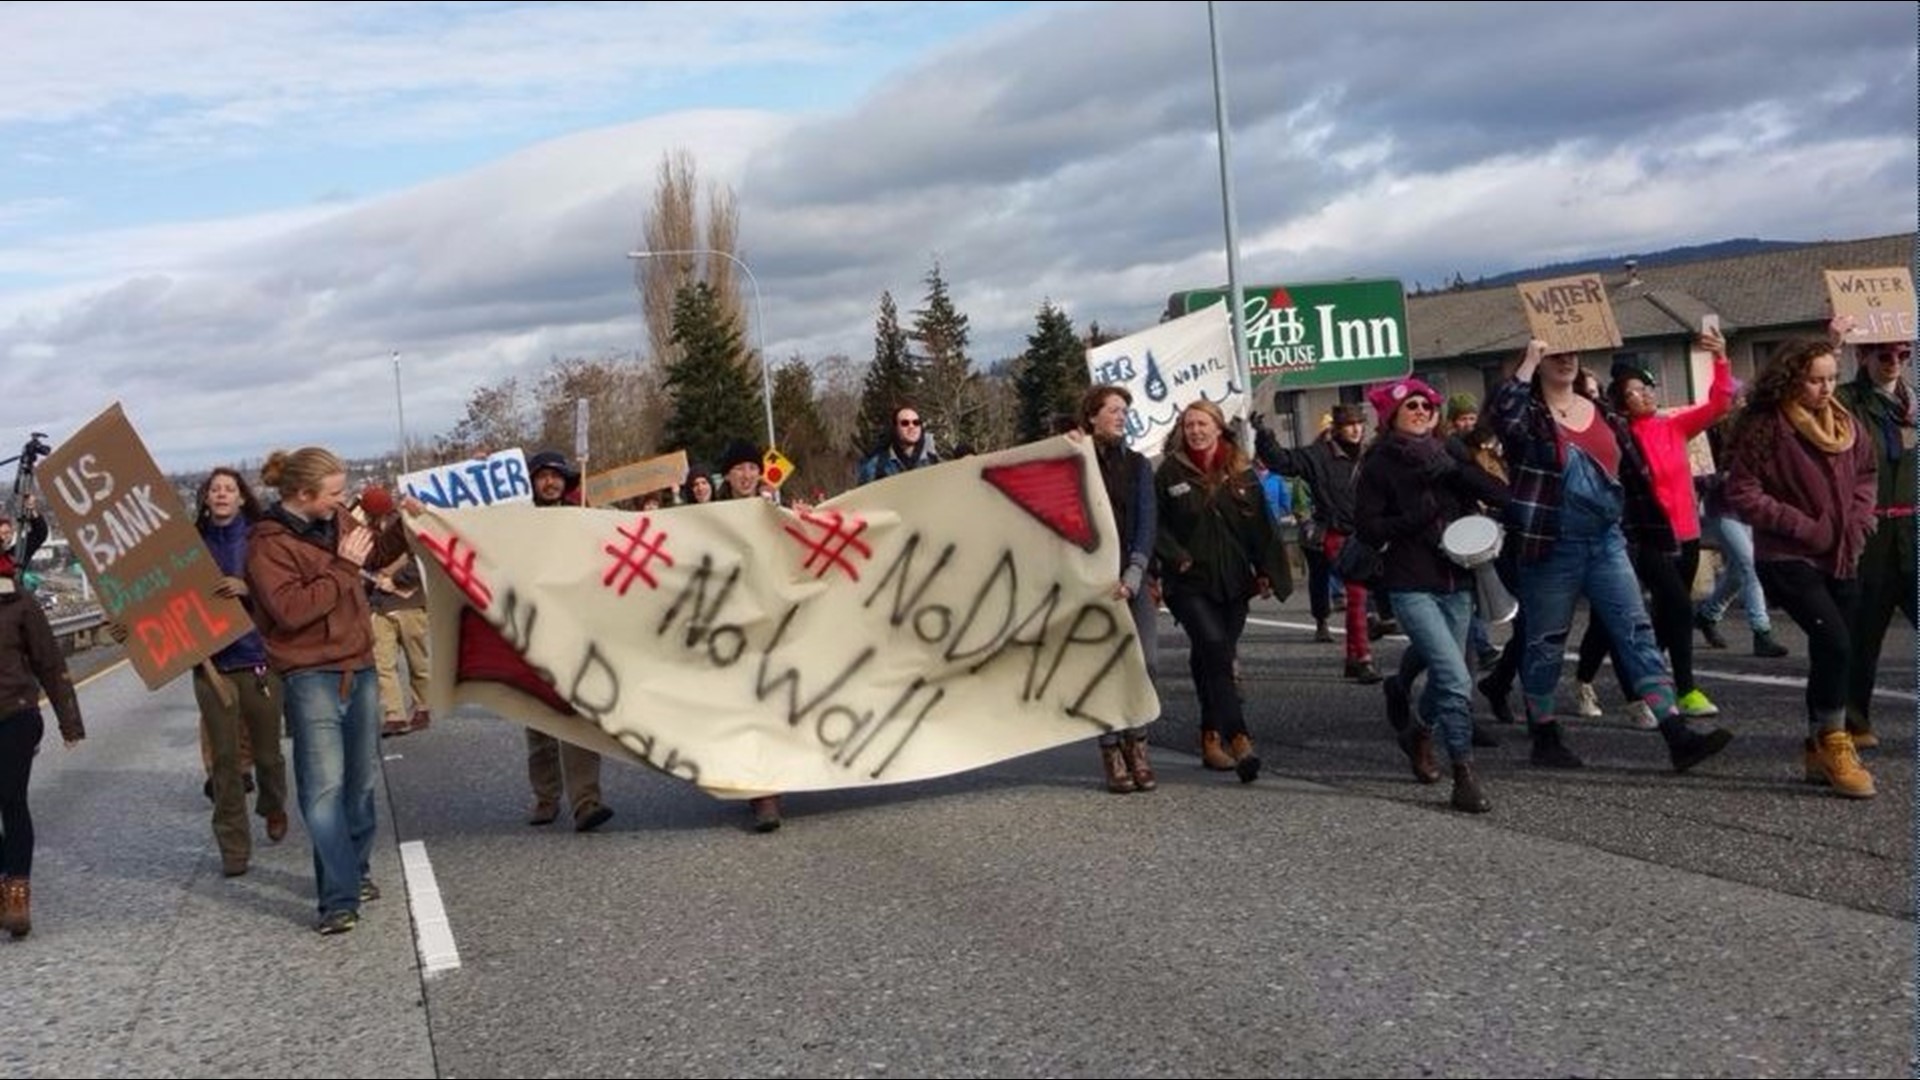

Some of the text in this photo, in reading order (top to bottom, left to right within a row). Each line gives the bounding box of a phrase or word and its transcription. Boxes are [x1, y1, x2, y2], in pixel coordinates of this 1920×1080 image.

[1525, 279, 1602, 313] WATER
[1832, 276, 1904, 293] WATER
[1315, 304, 1402, 362] Inn
[1554, 308, 1584, 325] IS
[53, 452, 114, 515] US
[407, 455, 529, 509] WATER
[77, 483, 171, 574] BANK
